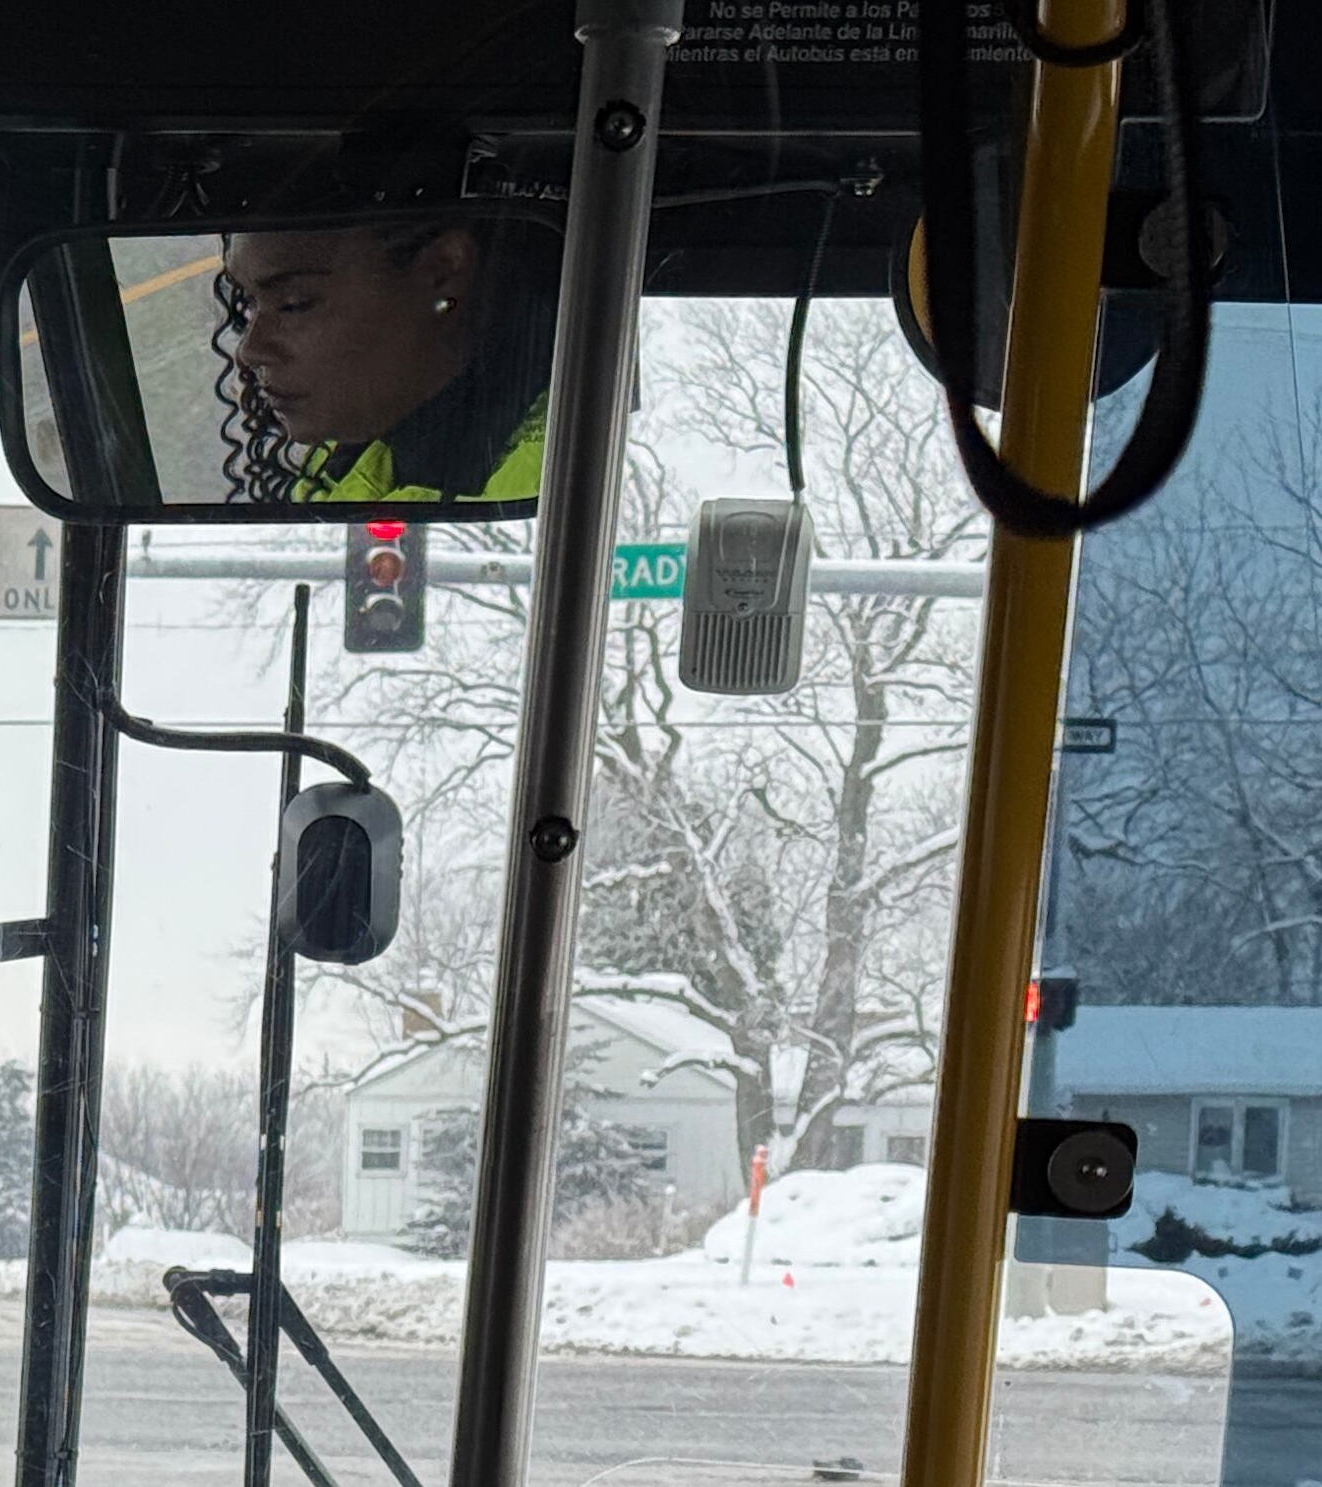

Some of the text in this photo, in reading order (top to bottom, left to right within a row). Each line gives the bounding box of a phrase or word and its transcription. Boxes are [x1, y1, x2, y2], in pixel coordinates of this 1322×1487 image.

[708, 1, 737, 19] No
[740, 5, 764, 19] se
[767, 1, 842, 19] Permite
[845, 5, 859, 19] a
[862, 0, 892, 19] los
[681, 25, 746, 41] ararse
[748, 23, 833, 41] Adelante
[836, 23, 862, 41] de
[865, 23, 884, 40] la
[744, 45, 762, 62] el
[895, 47, 920, 62] en
[612, 554, 687, 587] RAD
[4, 587, 56, 611] ONL
